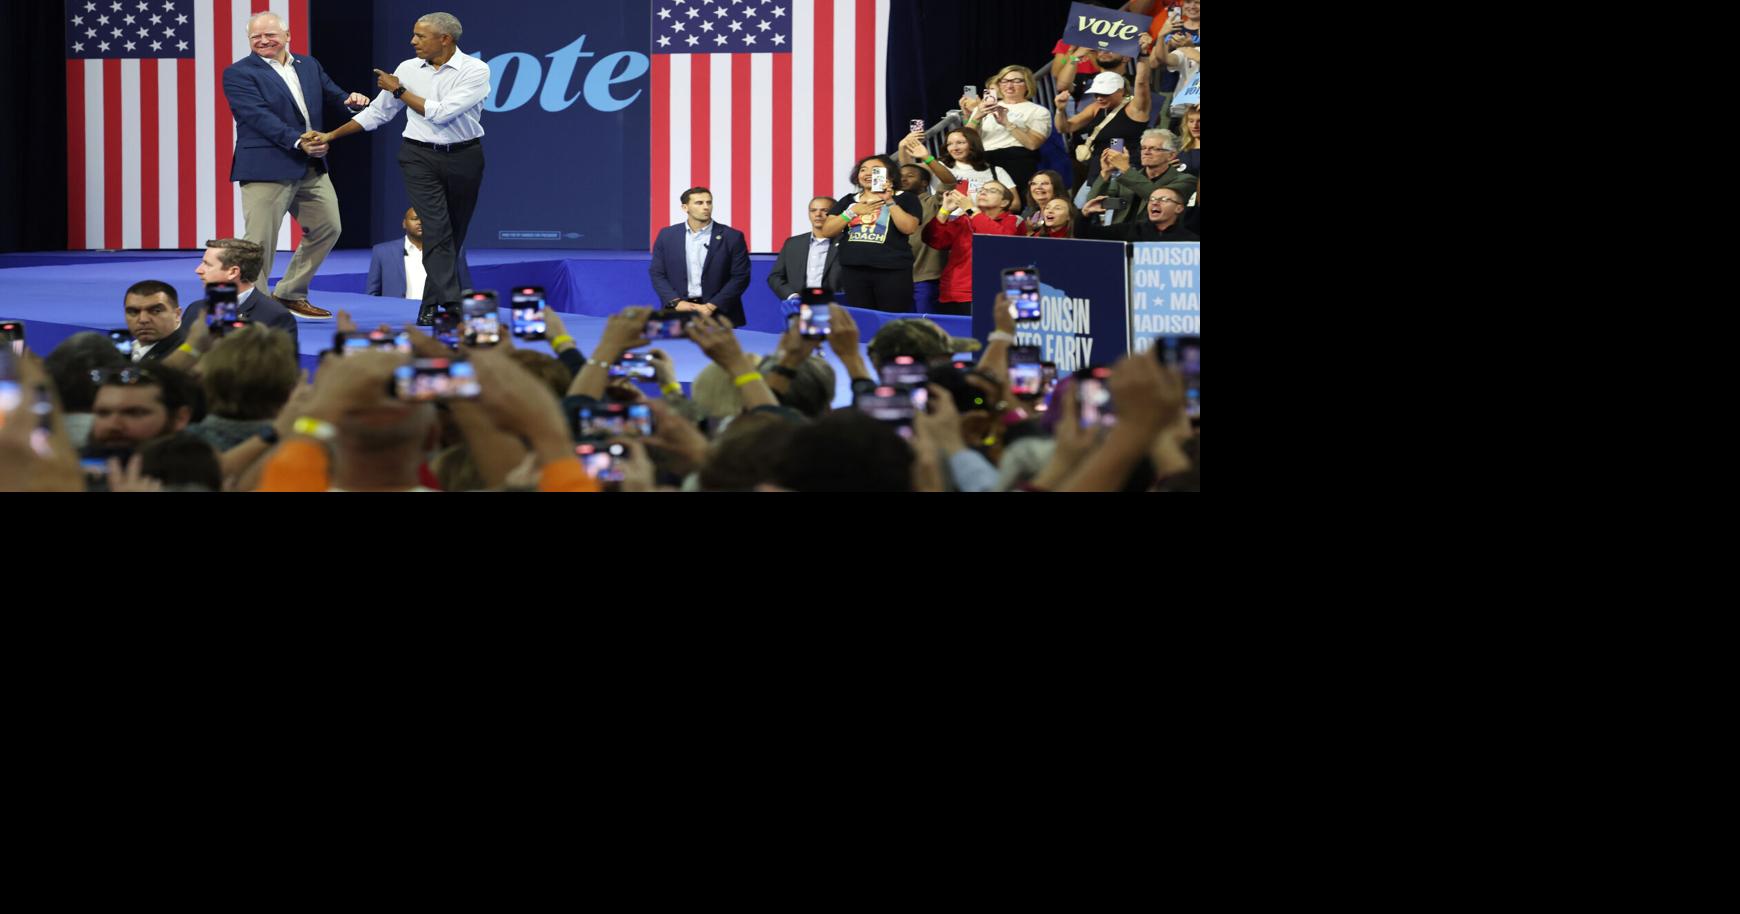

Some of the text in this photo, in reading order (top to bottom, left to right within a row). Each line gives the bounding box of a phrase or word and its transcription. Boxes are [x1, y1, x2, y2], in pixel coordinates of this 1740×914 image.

[1078, 15, 1138, 40] vote
[470, 34, 650, 112] ote
[1169, 270, 1193, 288] WI
